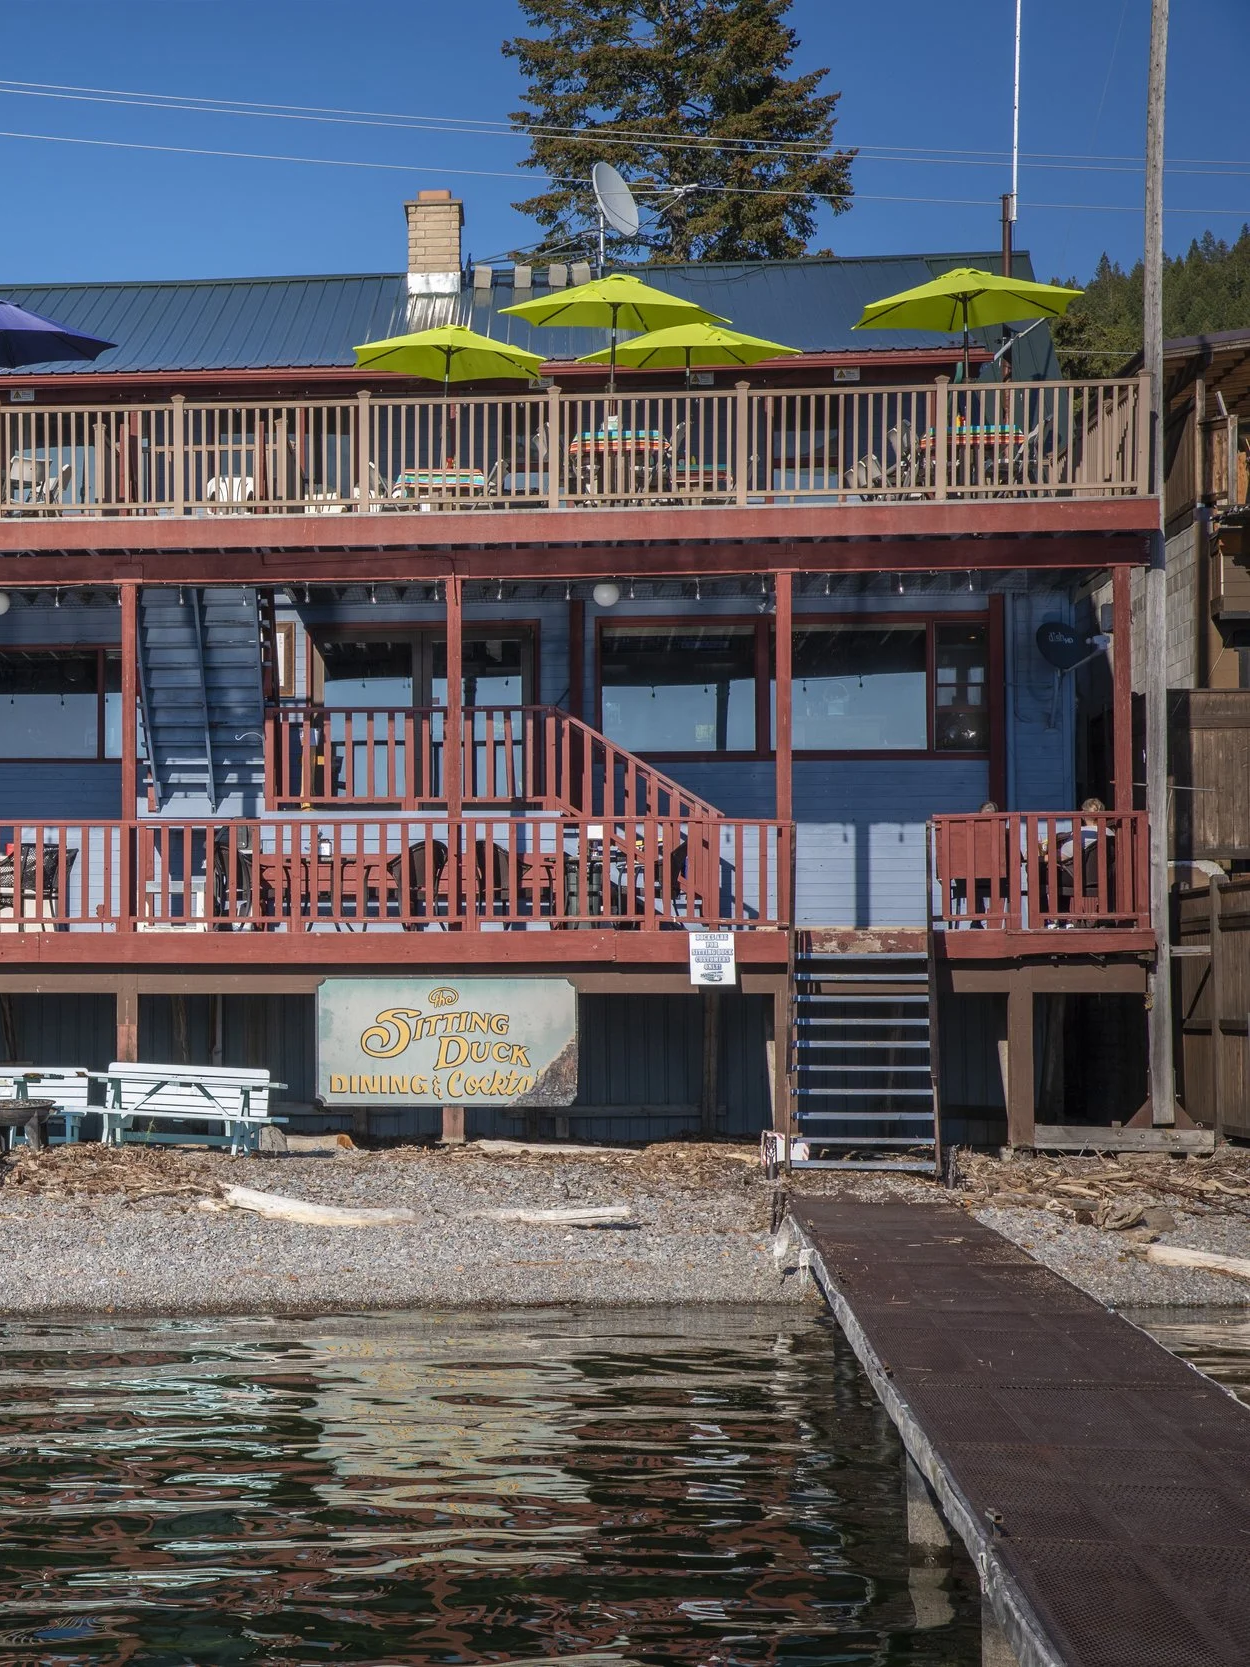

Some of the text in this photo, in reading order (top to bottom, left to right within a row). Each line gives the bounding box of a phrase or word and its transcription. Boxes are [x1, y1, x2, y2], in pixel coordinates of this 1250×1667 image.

[428, 986, 459, 1008] the
[360, 1007, 510, 1059] SITTING
[433, 1035, 531, 1071] DUCK
[329, 1073, 428, 1095] DINING
[432, 1075, 443, 1100] &
